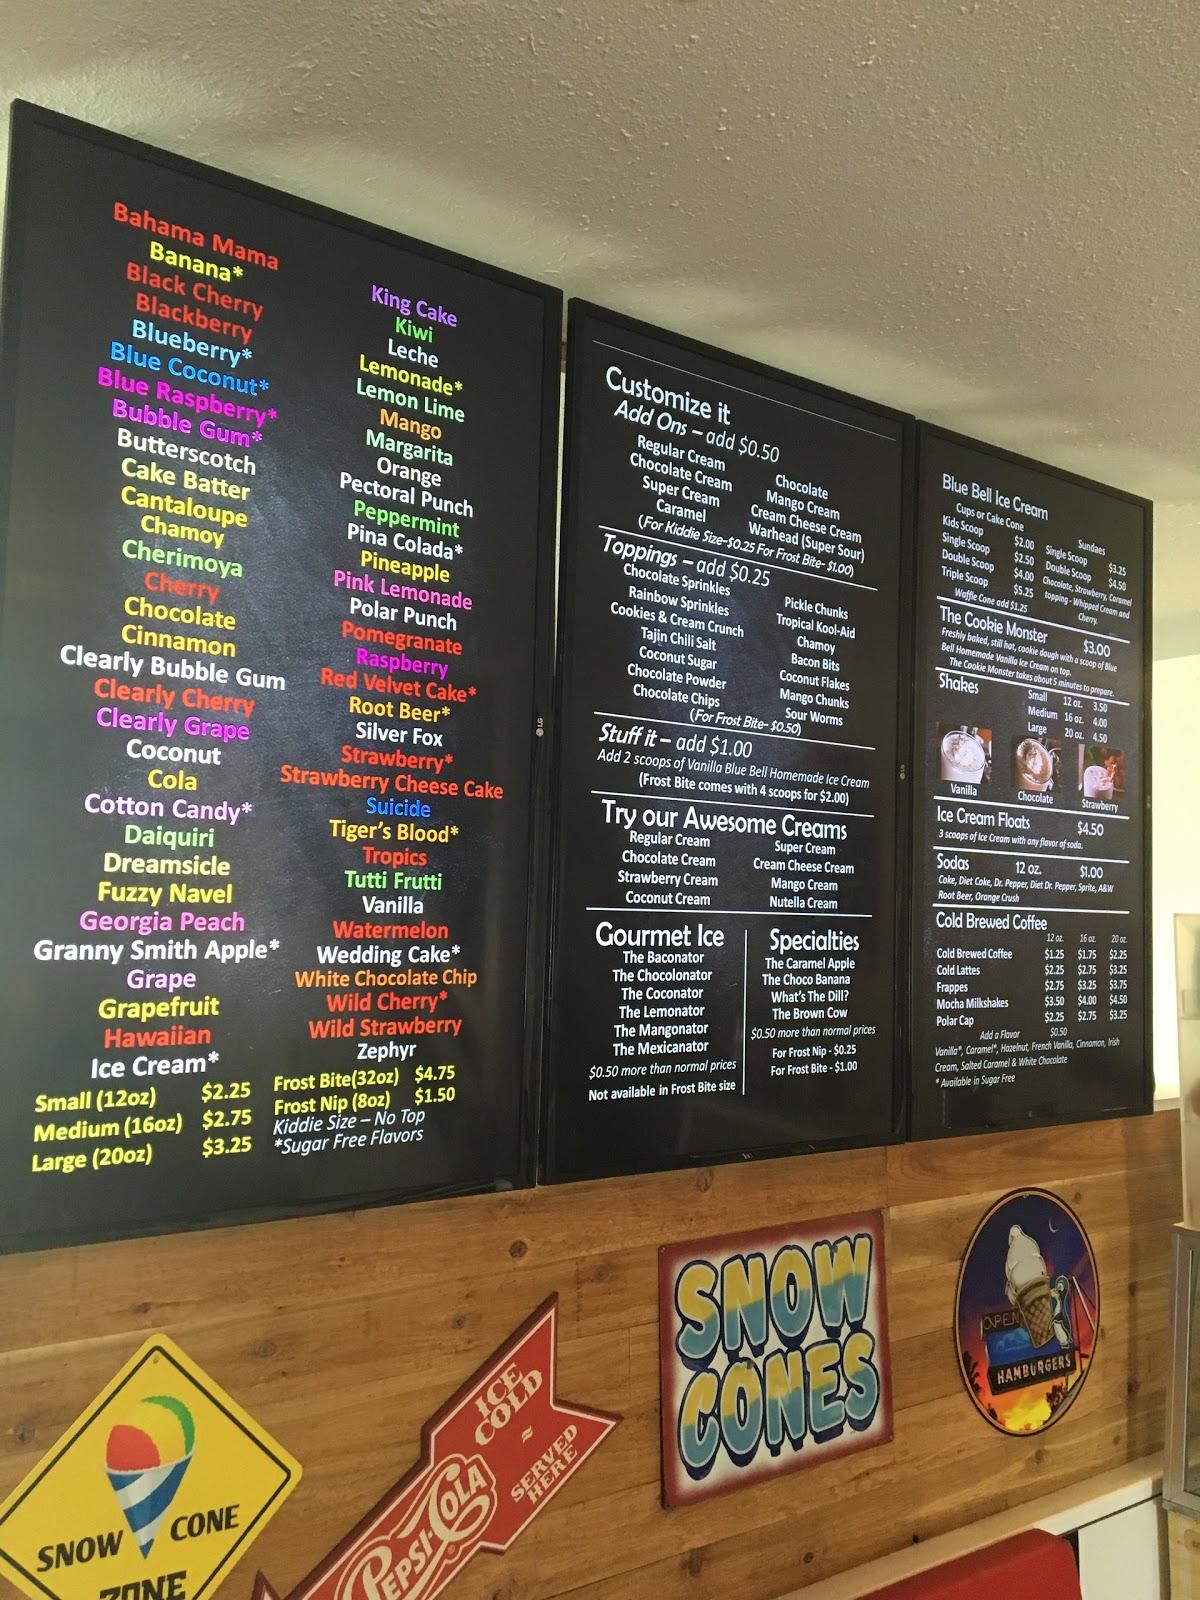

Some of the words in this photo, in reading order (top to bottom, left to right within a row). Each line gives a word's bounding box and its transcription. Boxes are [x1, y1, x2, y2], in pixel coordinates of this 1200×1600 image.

[113, 202, 205, 247] Bahama
[212, 233, 279, 271] Mama
[126, 261, 185, 295] Black
[192, 282, 263, 321] Cherry
[371, 284, 411, 316] King
[415, 299, 457, 327] Cake
[388, 337, 438, 368] Leche
[605, 365, 712, 419] Customize
[717, 401, 730, 425] it
[117, 427, 256, 476] Butterscotch
[366, 428, 453, 466] Margarita
[121, 485, 248, 528] Cantaloupe
[340, 471, 415, 505] Pectoral
[421, 490, 473, 518] Punch
[656, 498, 706, 523] Caramel
[766, 489, 804, 512] Mango
[806, 500, 840, 520] Cream
[942, 472, 968, 495] Blue
[971, 482, 992, 503] Bell
[995, 489, 1010, 509] Ice
[1012, 495, 1048, 520] Cream
[354, 499, 460, 538] Peppermint
[942, 514, 959, 529] Kids
[960, 519, 984, 538] Scoop
[1014, 534, 1034, 550] $2.00
[955, 502, 975, 518] Cups
[975, 510, 985, 520] or
[986, 511, 1004, 526] Cake
[1005, 517, 1024, 532] Cone
[748, 520, 799, 545] Warhead
[801, 533, 836, 554] (Super
[837, 543, 864, 564] Sour)
[1077, 538, 1105, 556] Sundaes
[122, 539, 242, 579] Cherimoya
[1045, 560, 1070, 576] Double
[1071, 567, 1091, 583] Scoop
[1108, 576, 1126, 591] $4.50
[124, 596, 236, 630] Chocolate
[628, 585, 678, 606] Rainbow
[680, 595, 729, 617] Sprinkles
[341, 620, 462, 655] Pomegranate
[640, 626, 667, 644] Tajin
[669, 631, 694, 647] Chili
[695, 636, 716, 651] Salt
[775, 612, 814, 631] Tropical
[816, 620, 855, 639] Kool-Aid
[939, 604, 961, 625] The
[964, 610, 1003, 634] Cookie
[1005, 620, 1048, 644] Monster
[1083, 638, 1110, 657] $3.00
[60, 644, 144, 677] Clearly
[150, 655, 228, 684] Bubble
[235, 667, 285, 691] Gum
[938, 671, 979, 694] Shakes
[96, 706, 178, 737] Clearly
[184, 716, 250, 743] Grape
[1027, 705, 1058, 720] Medium
[1064, 711, 1073, 722] 16
[1073, 715, 1084, 724] oz.
[1092, 716, 1107, 728] 4.00
[355, 721, 408, 743] Silver
[412, 727, 443, 747] Fox
[126, 738, 221, 765] Coconut
[280, 764, 389, 794] Strawberry
[394, 774, 458, 796] Cheese
[463, 779, 503, 799] Cake
[596, 748, 622, 763] Add
[622, 750, 631, 764] 2
[632, 754, 672, 770] scoops
[673, 756, 686, 772] of
[687, 757, 722, 773] Vanilla
[724, 761, 747, 776] Blue
[748, 764, 768, 778] Bell
[769, 767, 824, 784] Homemade
[825, 773, 839, 785] Ice
[840, 774, 870, 788] Cream
[950, 783, 977, 796] Vanilla
[1081, 798, 1118, 813] Strawberry
[601, 798, 637, 829] Try
[642, 809, 678, 828] our
[682, 805, 777, 835] Awesome
[781, 813, 847, 840] Creams
[937, 804, 953, 822] Ice
[956, 807, 995, 826] Cream
[997, 811, 1030, 829] Floats
[1077, 820, 1104, 836] $4.50
[124, 824, 214, 851] Daiquiri
[98, 881, 163, 907] Fuzzy
[169, 883, 232, 904] Navel
[343, 869, 387, 889] Tutti
[394, 871, 442, 890] Frutti
[617, 869, 681, 887] Strawberry
[683, 872, 718, 886] Cream
[769, 895, 805, 908] Nutella
[806, 896, 838, 909] Cream
[332, 920, 449, 939] Watermelon
[595, 921, 691, 946] Gourmet
[697, 923, 724, 947] Ice
[769, 927, 859, 955] Specialties
[126, 968, 196, 993] Grape
[294, 969, 350, 988] White
[354, 968, 438, 986] Chocolate
[442, 968, 477, 988] Chip
[611, 968, 634, 982] The
[636, 967, 713, 982] Chocolonator
[936, 981, 968, 995] Frappes
[1044, 978, 1064, 992] $2.75
[1077, 978, 1097, 991] $3.25
[1108, 978, 1127, 990] $3.75
[807, 989, 825, 1002] The
[827, 989, 849, 1002] Dill?
[104, 1024, 211, 1048] Hawaiian
[356, 1040, 416, 1063] Zephyr
[34, 1090, 92, 1113] Small
[96, 1086, 156, 1112] (12oz)
[201, 1081, 251, 1103] $2.25
[274, 1097, 316, 1115] Frost
[320, 1094, 348, 1114] Nip
[351, 1090, 390, 1112] (8oz)
[414, 1086, 455, 1106] $1.50
[588, 1088, 608, 1101] Not
[610, 1084, 656, 1099] available
[658, 1083, 668, 1095] in
[670, 1082, 695, 1095] Frost
[697, 1080, 717, 1093] Bite
[718, 1079, 736, 1091] size
[31, 1154, 87, 1173] Large
[92, 1143, 152, 1170] (20oz)
[202, 1135, 252, 1158] $3.25
[674, 1232, 872, 1371] SNOW
[983, 1311, 1020, 1330] OPEN
[996, 1352, 1072, 1385] HAMBURGERS
[474, 1362, 524, 1419] ICE
[677, 1327, 881, 1481] CONES
[474, 1369, 543, 1446] COLD
[510, 1424, 578, 1503] SERVED
[525, 1444, 578, 1505] HERE
[36, 1529, 124, 1573] SNOW
[169, 1503, 241, 1542] CONE
